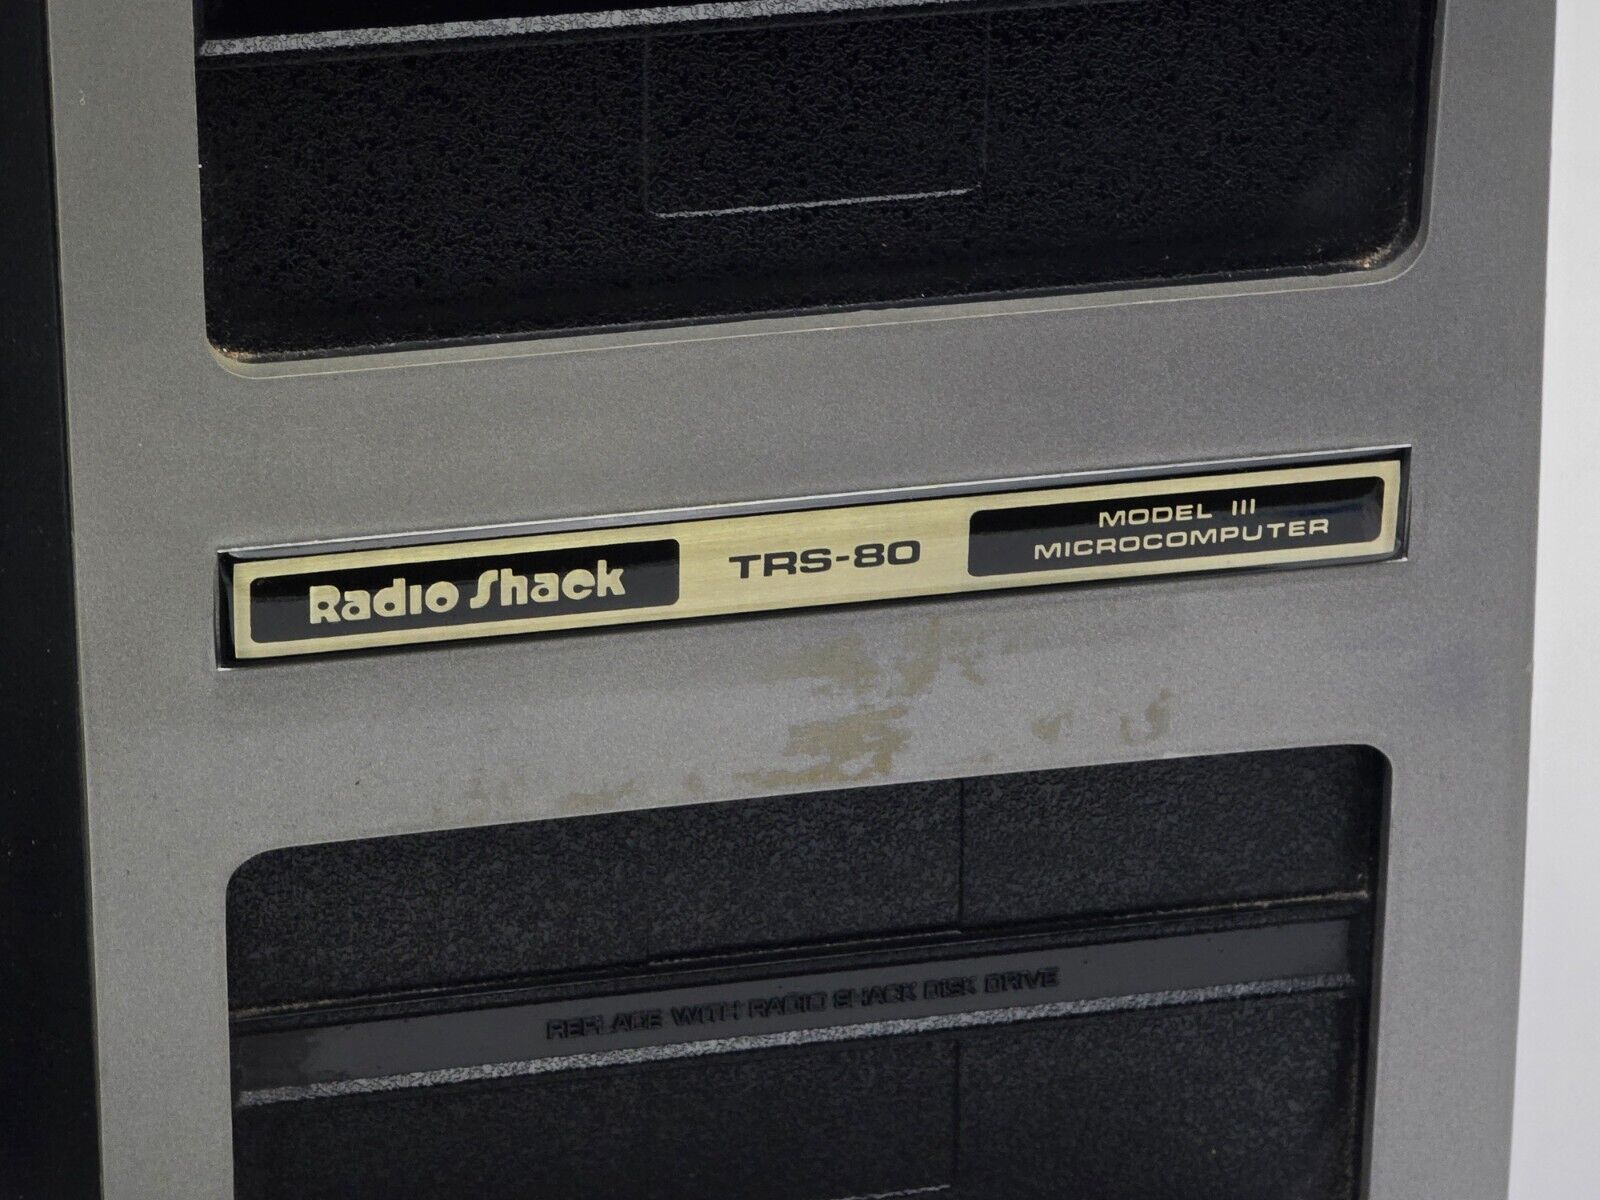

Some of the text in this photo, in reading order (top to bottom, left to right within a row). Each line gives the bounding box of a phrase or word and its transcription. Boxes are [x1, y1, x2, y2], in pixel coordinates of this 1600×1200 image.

[1098, 498, 1257, 528] MODEL III
[729, 540, 922, 578] TRS-80
[1033, 518, 1330, 560] MICROCOMPUTER
[309, 559, 626, 624] Radio Shack
[671, 1000, 742, 1026] WITH
[748, 991, 827, 1018] RADIO
[833, 982, 916, 1009] SHACK
[922, 977, 977, 999] DISK
[984, 967, 1060, 992] DRIVE
